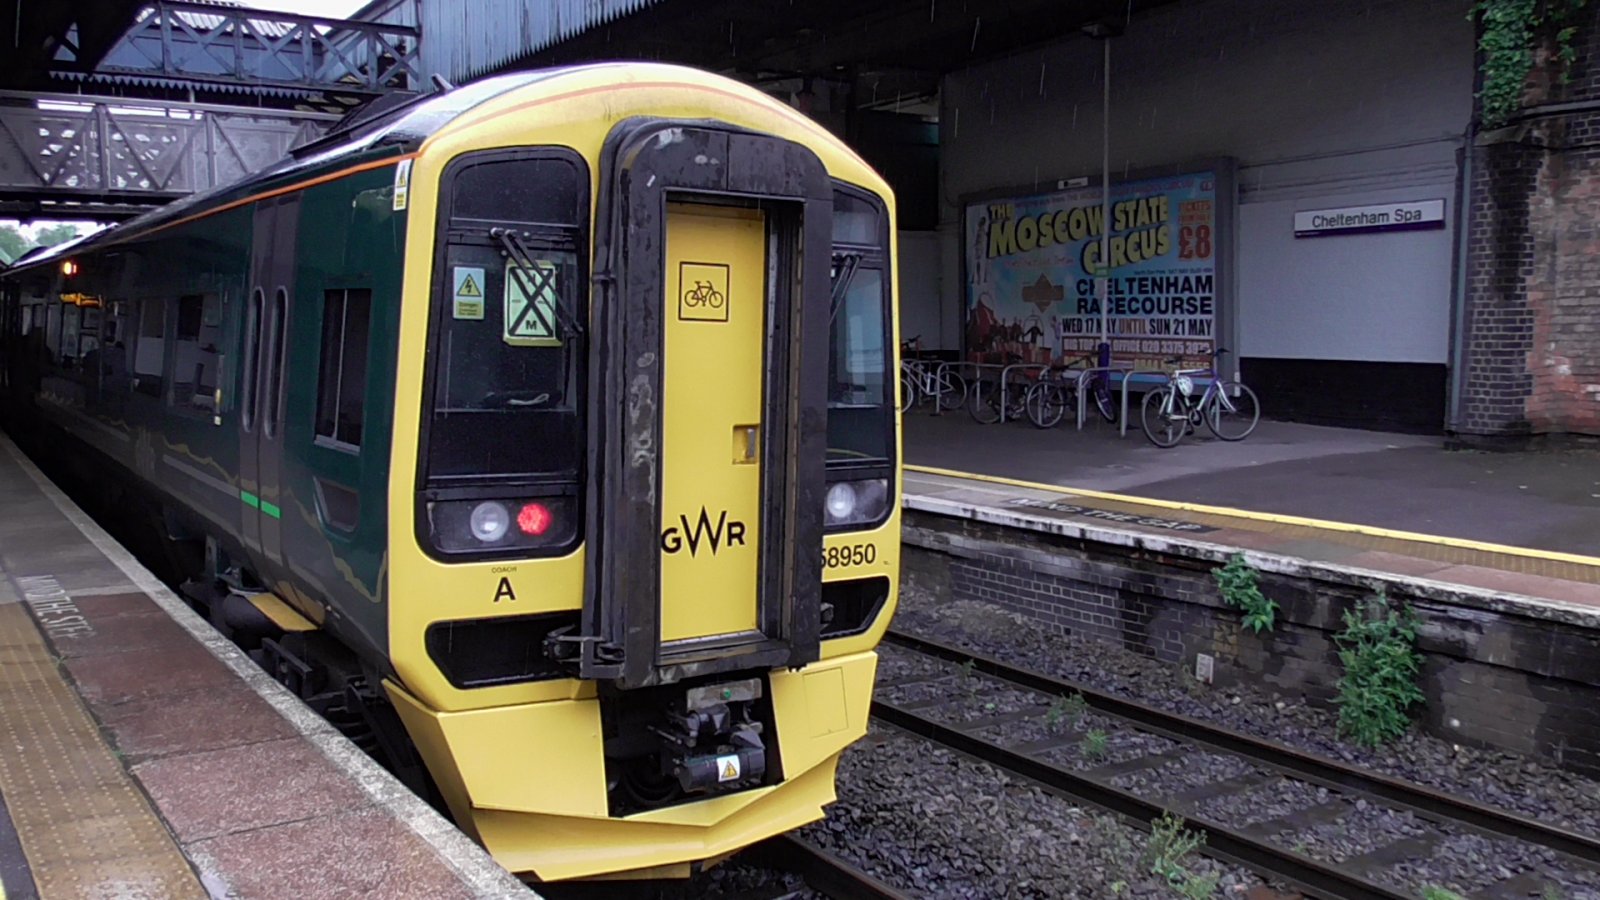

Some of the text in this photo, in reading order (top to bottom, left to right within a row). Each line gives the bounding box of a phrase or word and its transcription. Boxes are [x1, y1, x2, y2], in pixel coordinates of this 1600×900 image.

[988, 203, 1014, 221] THE
[1312, 209, 1422, 228] Cheltenham Spa
[987, 194, 1169, 259] MOSCOW STATE
[1178, 225, 1211, 259] £8
[525, 320, 537, 331] M
[1062, 318, 1083, 334] WED
[1085, 318, 1094, 334] 17
[1119, 318, 1147, 335] UNTIL
[1149, 318, 1171, 335] SUN
[1173, 318, 1186, 336] 21
[1188, 318, 1213, 336] MAY
[661, 504, 746, 559] GWR
[1138, 518, 1202, 531] GAP
[493, 576, 517, 603] A
